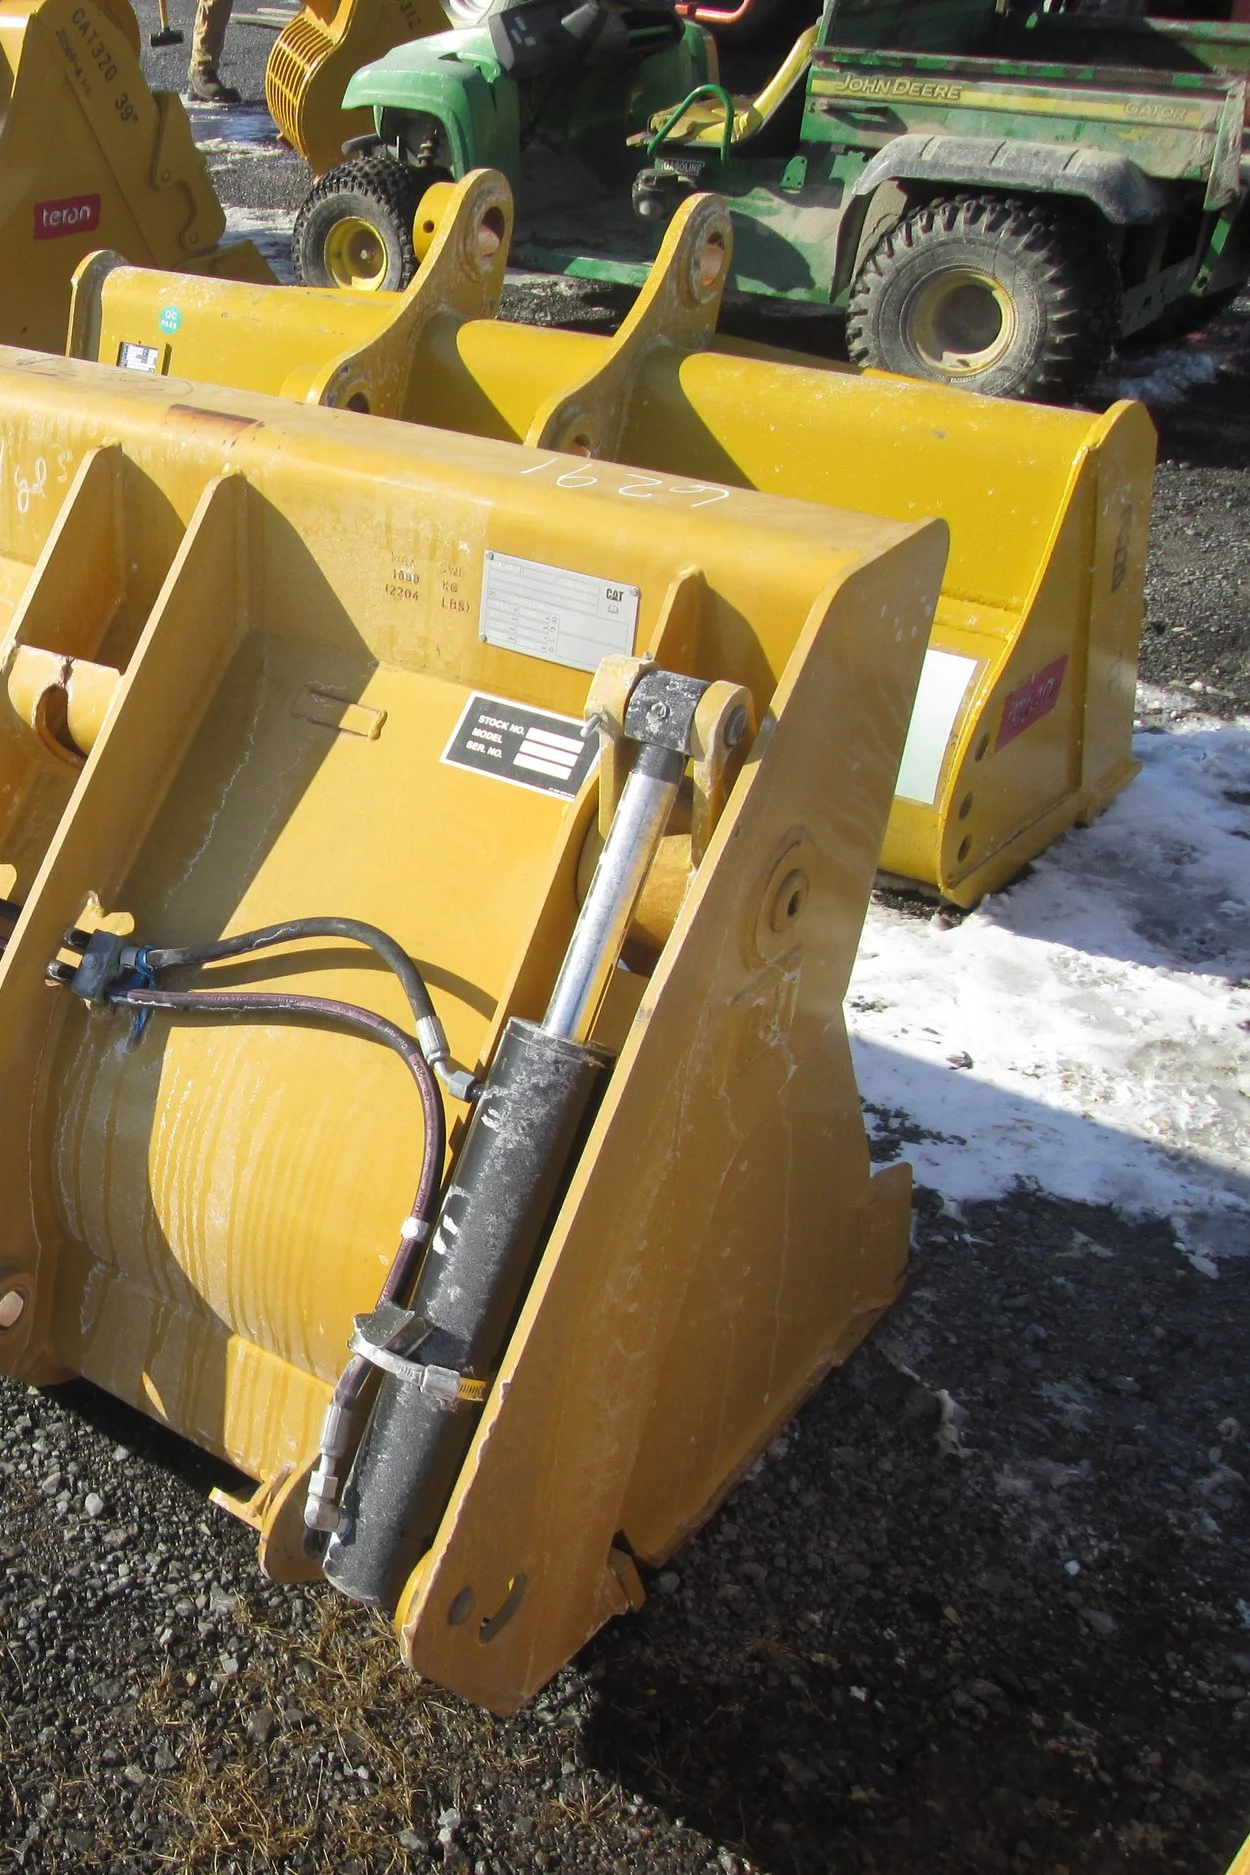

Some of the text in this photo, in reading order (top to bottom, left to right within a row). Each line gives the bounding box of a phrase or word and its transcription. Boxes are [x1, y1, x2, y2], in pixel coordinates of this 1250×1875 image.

[72, 8, 117, 81] CAT320
[836, 75, 963, 100] JOHN DEERE
[42, 205, 91, 227] teran
[165, 310, 178, 320] QC
[160, 319, 177, 330] PASS
[442, 580, 458, 593] KG
[605, 587, 625, 603] CAT
[477, 715, 526, 736] STOCK NO.
[471, 727, 503, 743] MODEL
[466, 740, 503, 759] SER. NO.
